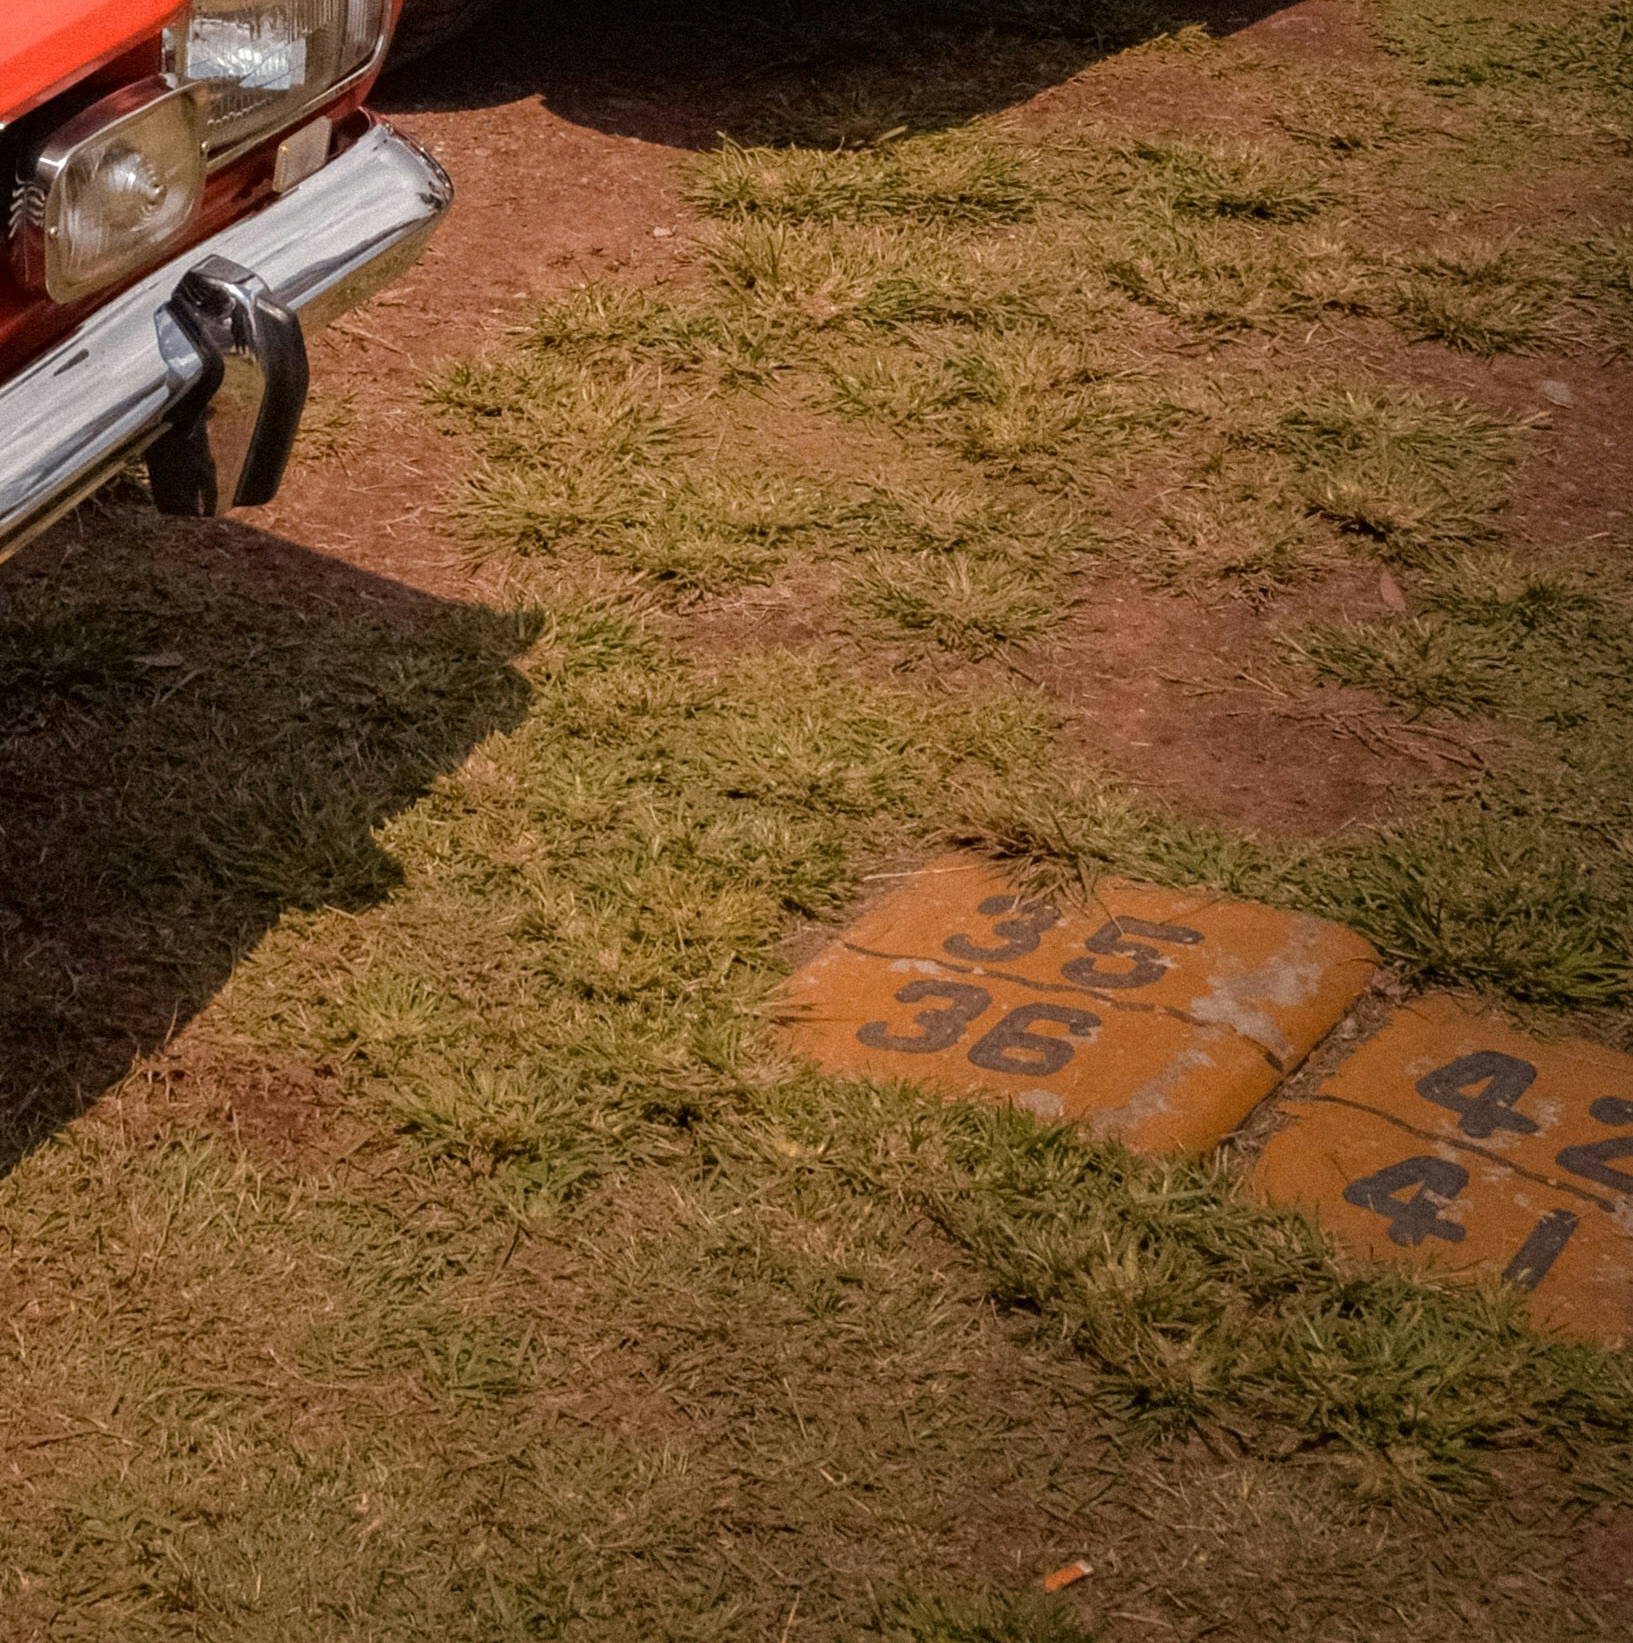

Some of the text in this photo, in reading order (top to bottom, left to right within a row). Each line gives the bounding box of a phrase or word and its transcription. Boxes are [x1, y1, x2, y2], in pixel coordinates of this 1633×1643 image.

[942, 894, 1206, 990] 35
[856, 978, 1103, 1077] 36
[1343, 1156, 1580, 1291] 41
